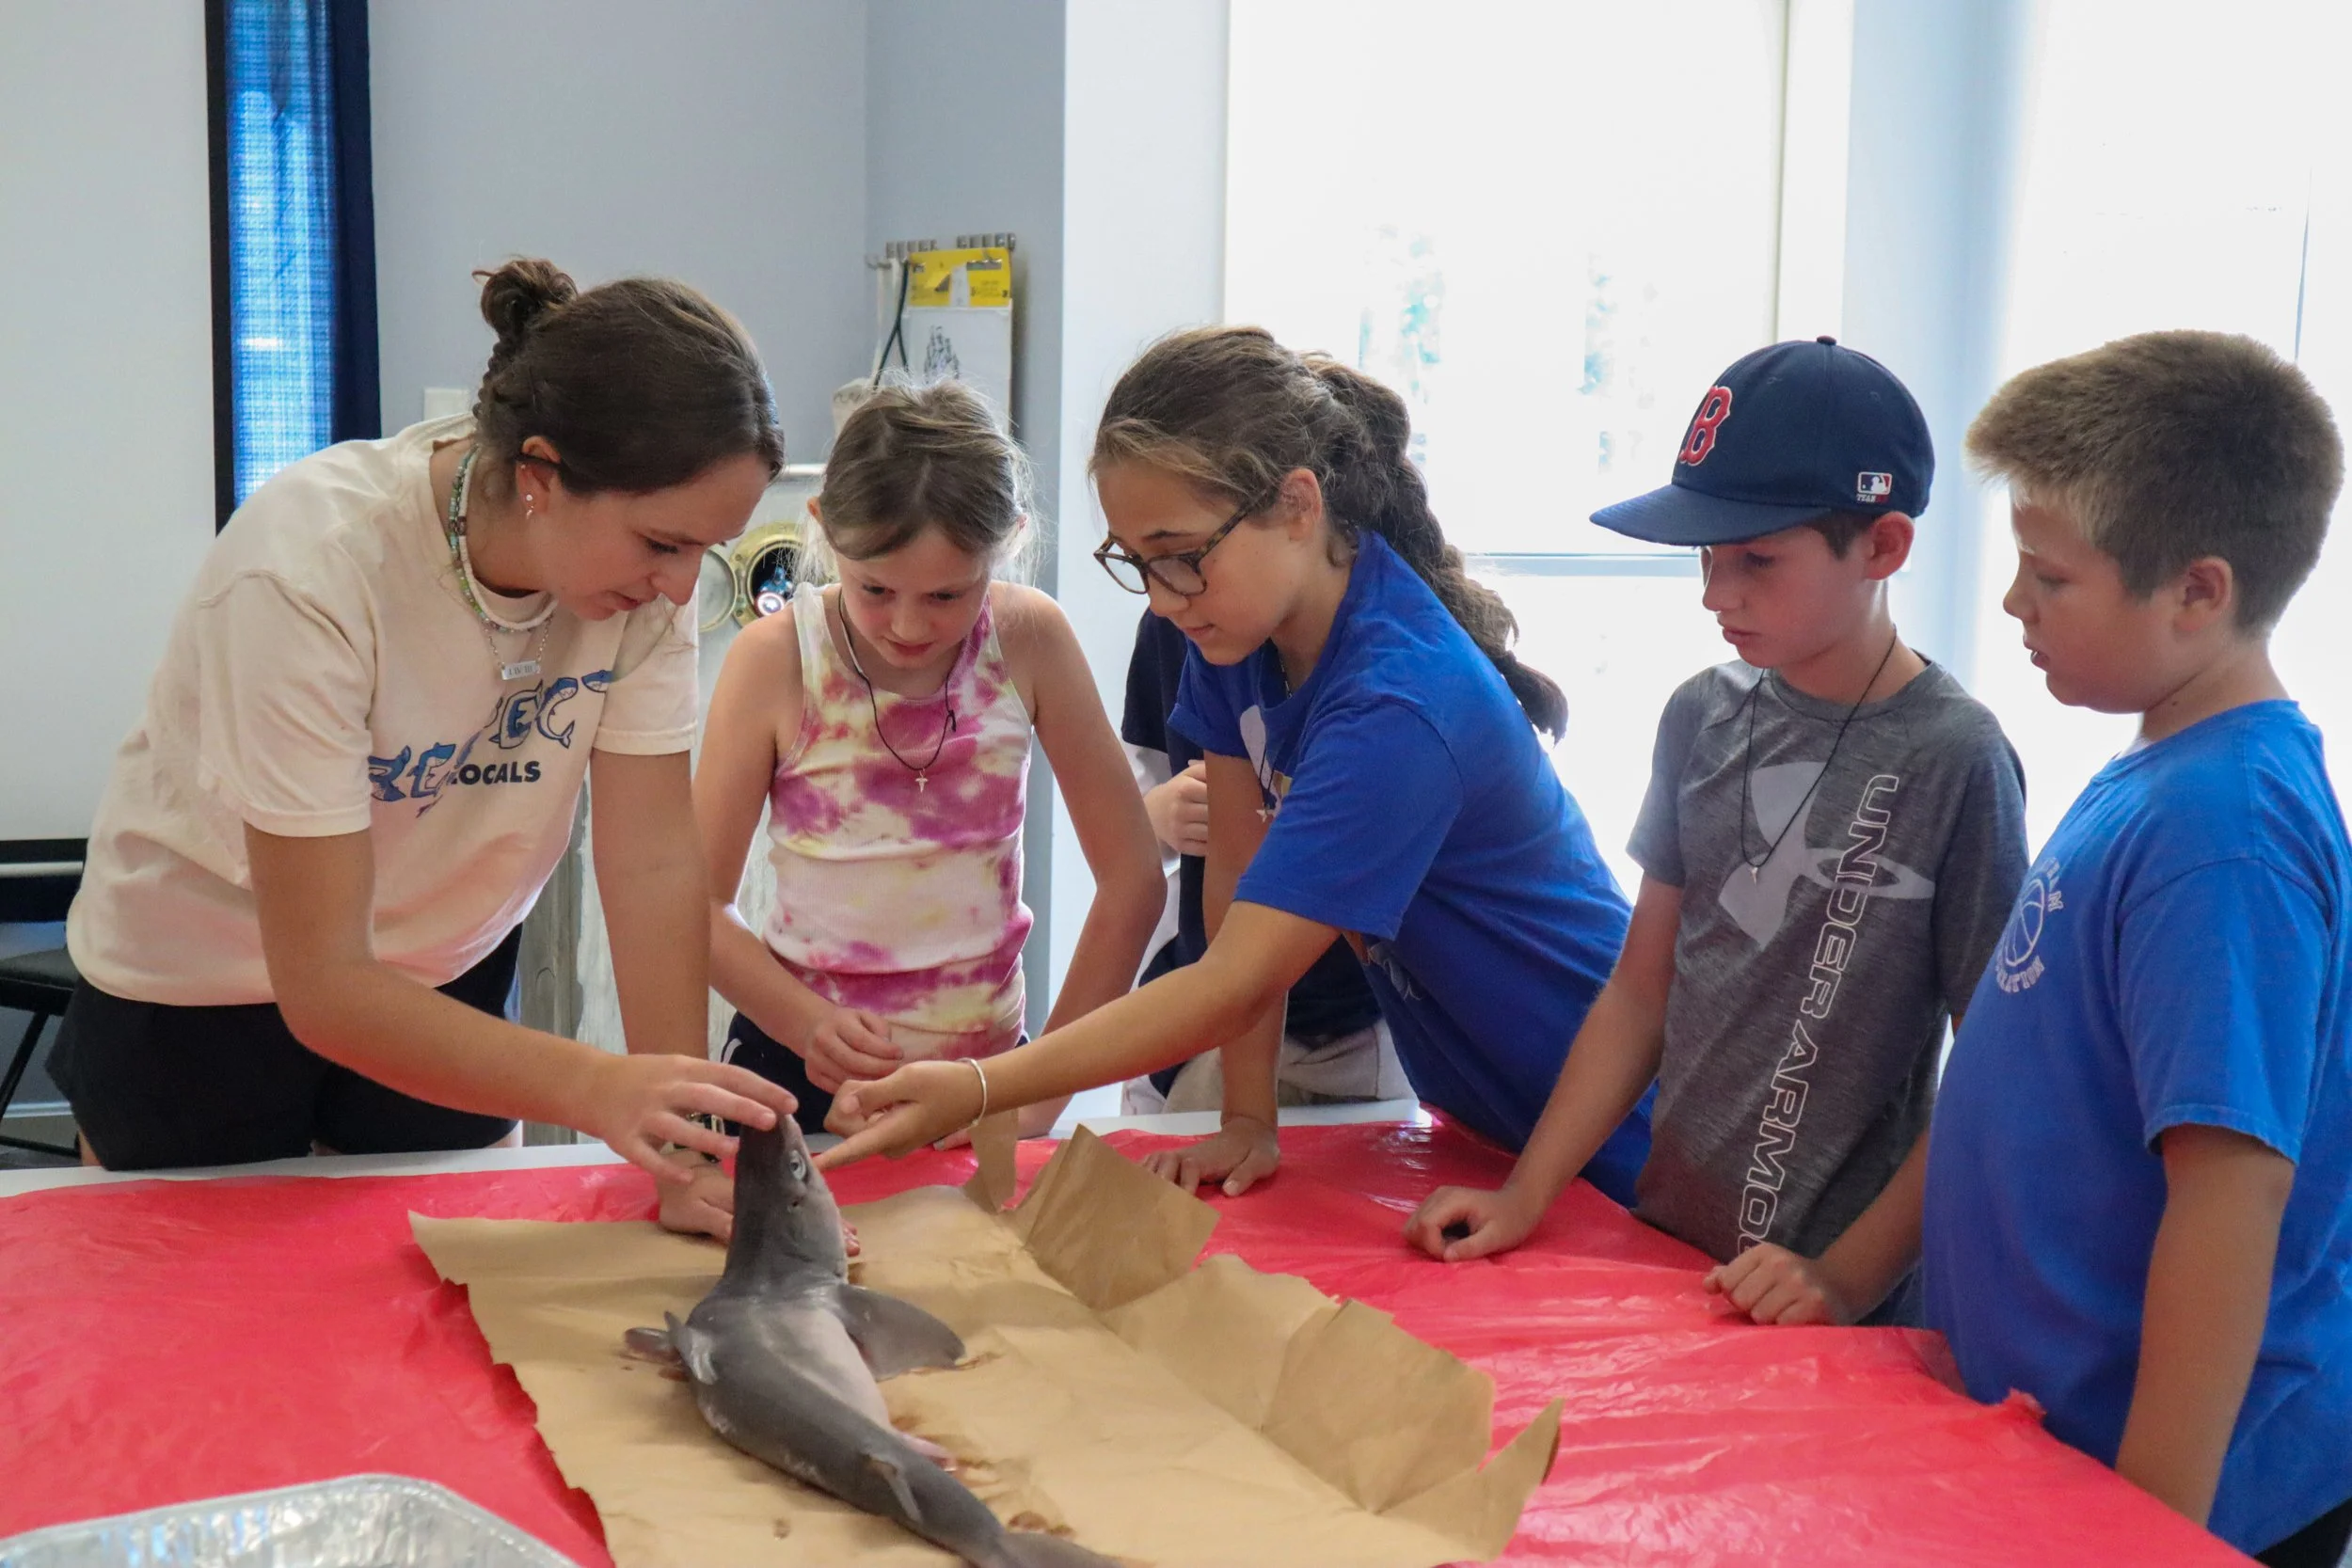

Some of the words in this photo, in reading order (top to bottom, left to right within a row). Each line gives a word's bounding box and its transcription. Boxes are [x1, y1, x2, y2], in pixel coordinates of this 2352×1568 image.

[1678, 385, 1733, 467] B
[1801, 774, 1899, 1020] UNDER
[1738, 1019, 1819, 1256] ARMO
